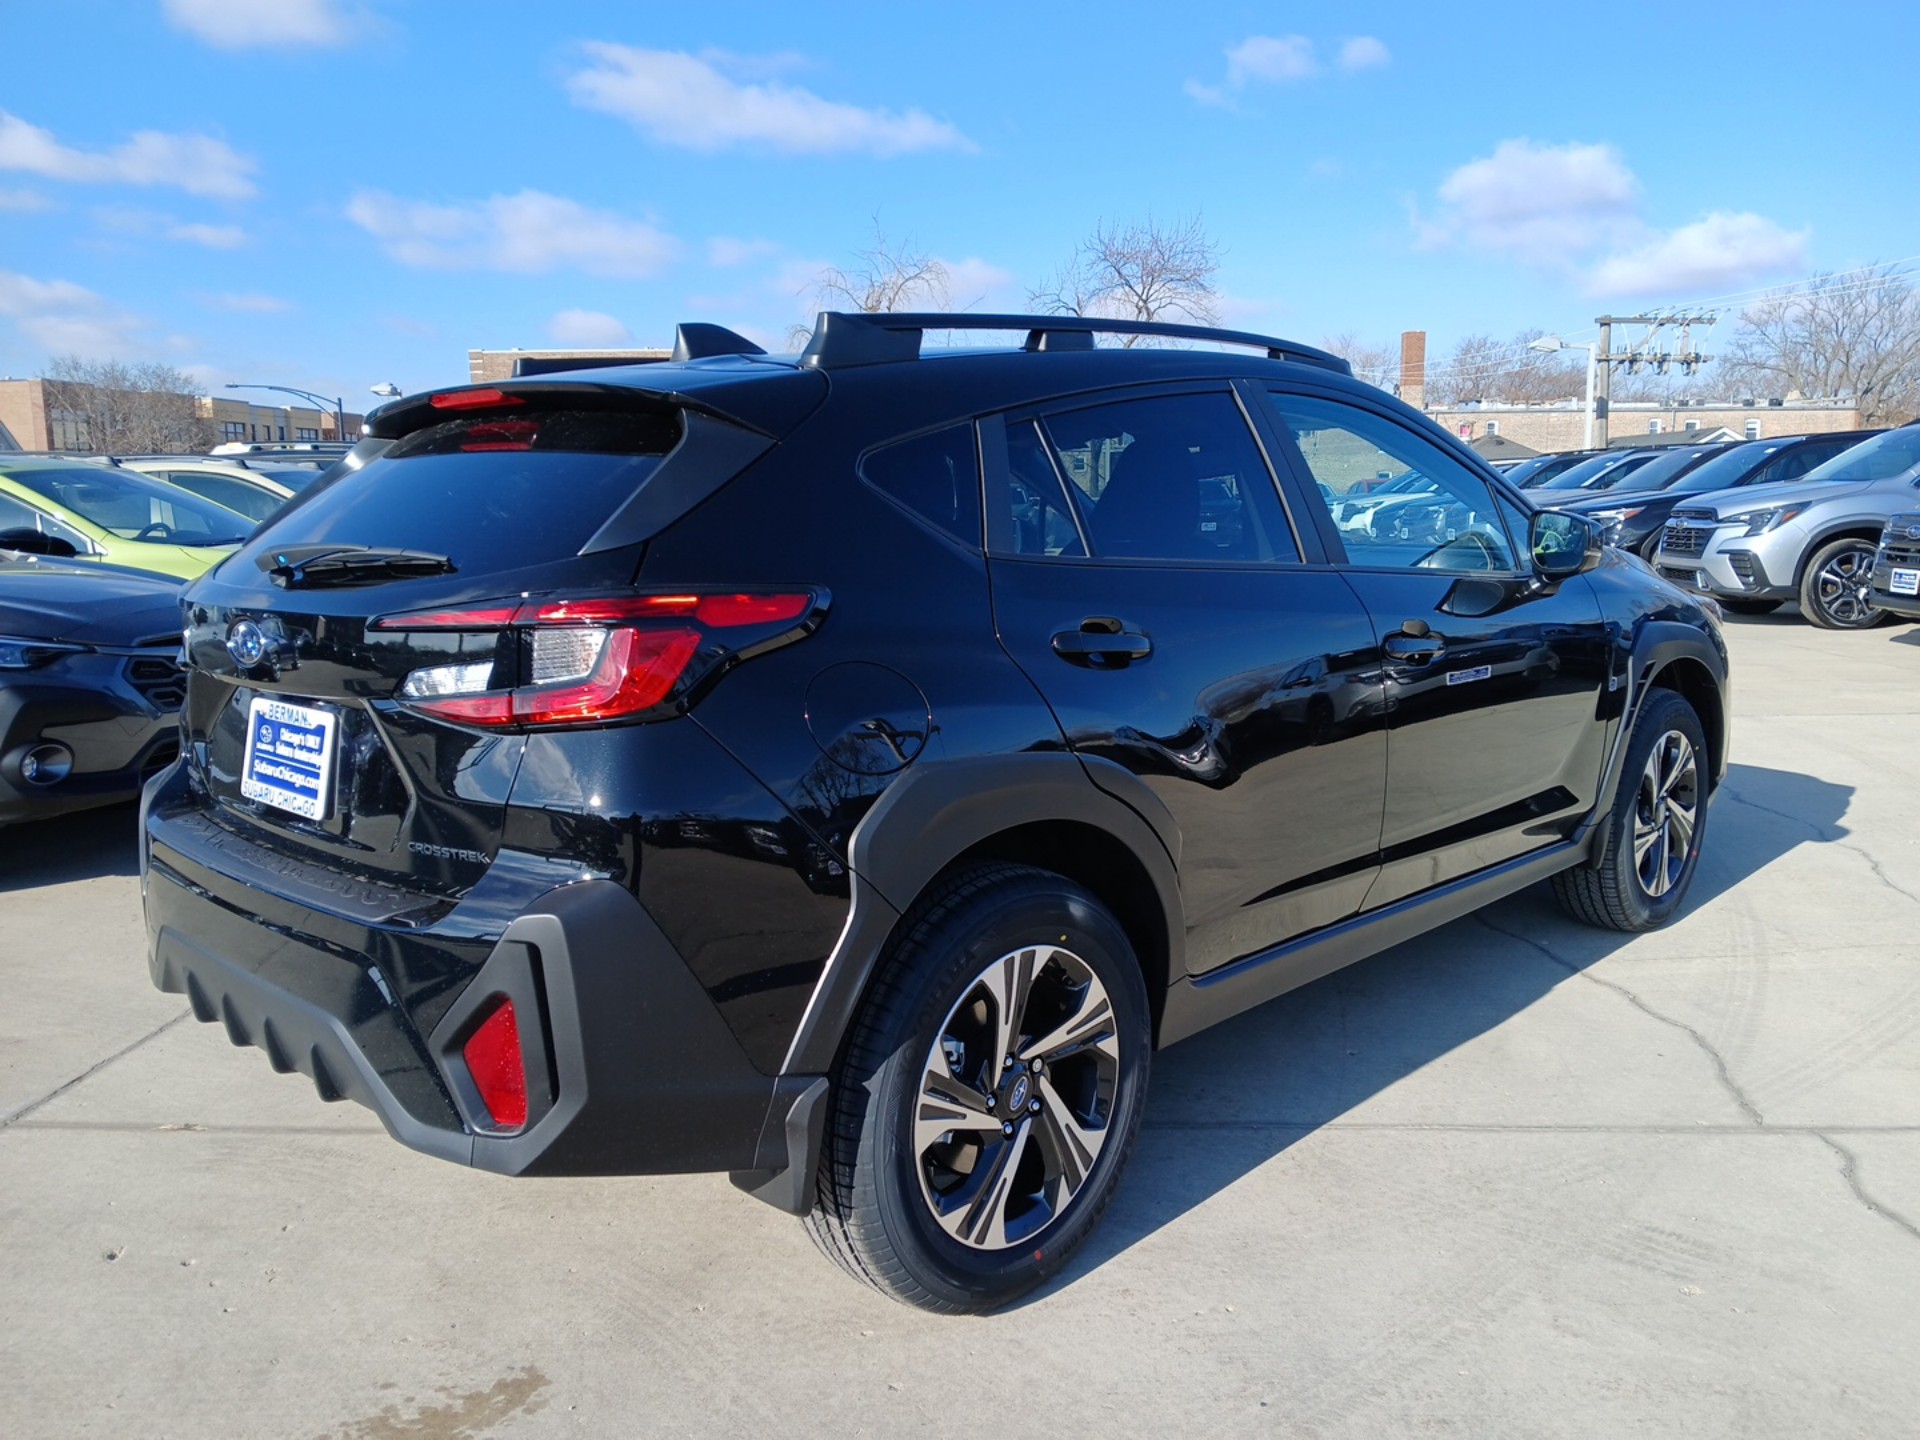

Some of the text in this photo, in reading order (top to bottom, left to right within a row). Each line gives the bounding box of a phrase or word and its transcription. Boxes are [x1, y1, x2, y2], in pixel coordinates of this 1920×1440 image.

[269, 704, 308, 725] BERMAN
[242, 780, 316, 817] SUBARU CHICAGO
[407, 841, 489, 864] CROSSTREK
